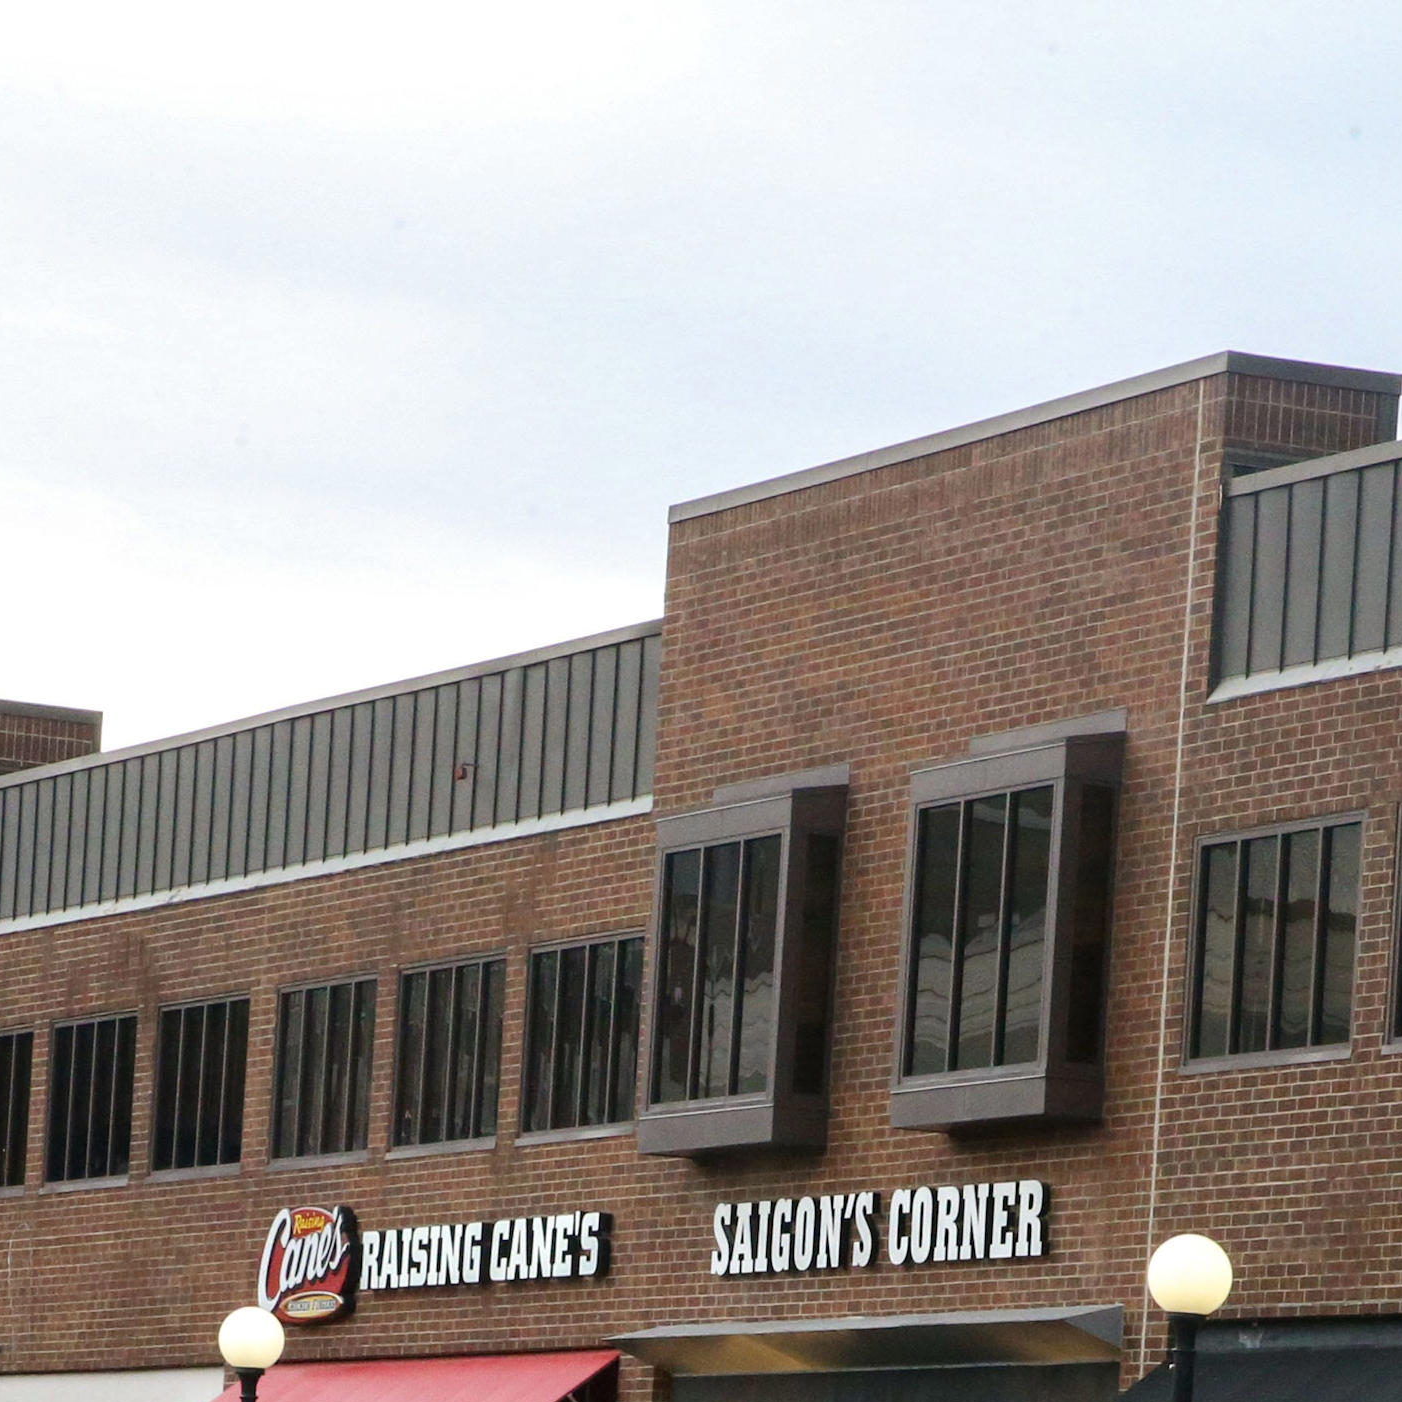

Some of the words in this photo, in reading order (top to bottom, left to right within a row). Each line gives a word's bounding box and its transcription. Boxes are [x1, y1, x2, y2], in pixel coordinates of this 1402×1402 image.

[258, 1205, 350, 1312] Cane's
[360, 1222, 483, 1291] RAISING
[490, 1211, 601, 1281] CANE'S
[711, 1191, 875, 1276] SAIGON'S
[888, 1180, 1045, 1265] CORNER
